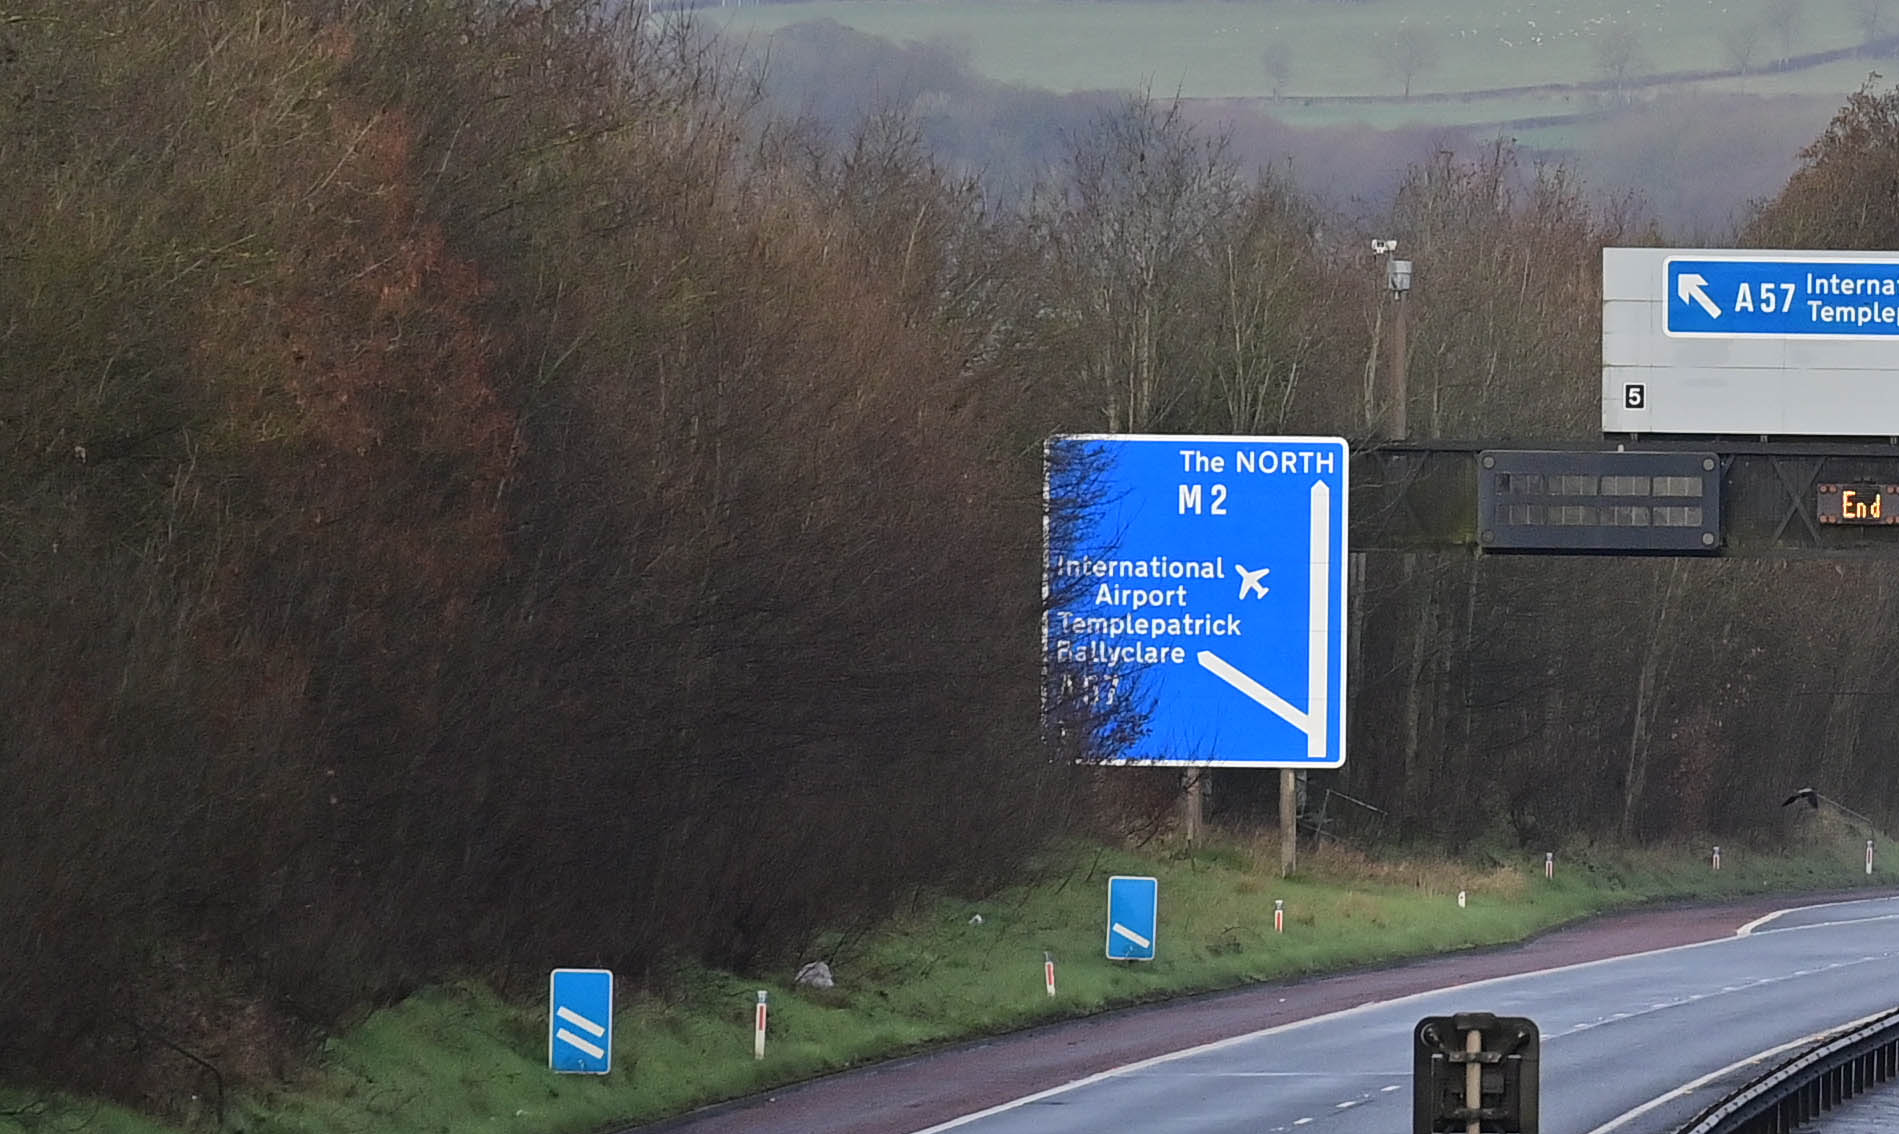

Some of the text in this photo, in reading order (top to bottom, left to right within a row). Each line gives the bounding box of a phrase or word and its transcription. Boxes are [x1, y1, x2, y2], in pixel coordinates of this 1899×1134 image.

[1734, 282, 1796, 313] A57
[1628, 387, 1641, 406] 5
[1180, 450, 1334, 474] The NORTH
[1178, 484, 1228, 515] M2
[1842, 490, 1881, 519] End
[1057, 555, 1225, 578] International
[1095, 583, 1187, 610] Airport
[1057, 611, 1241, 639] Templepatrick
[1057, 640, 1186, 667] Ballyclare
